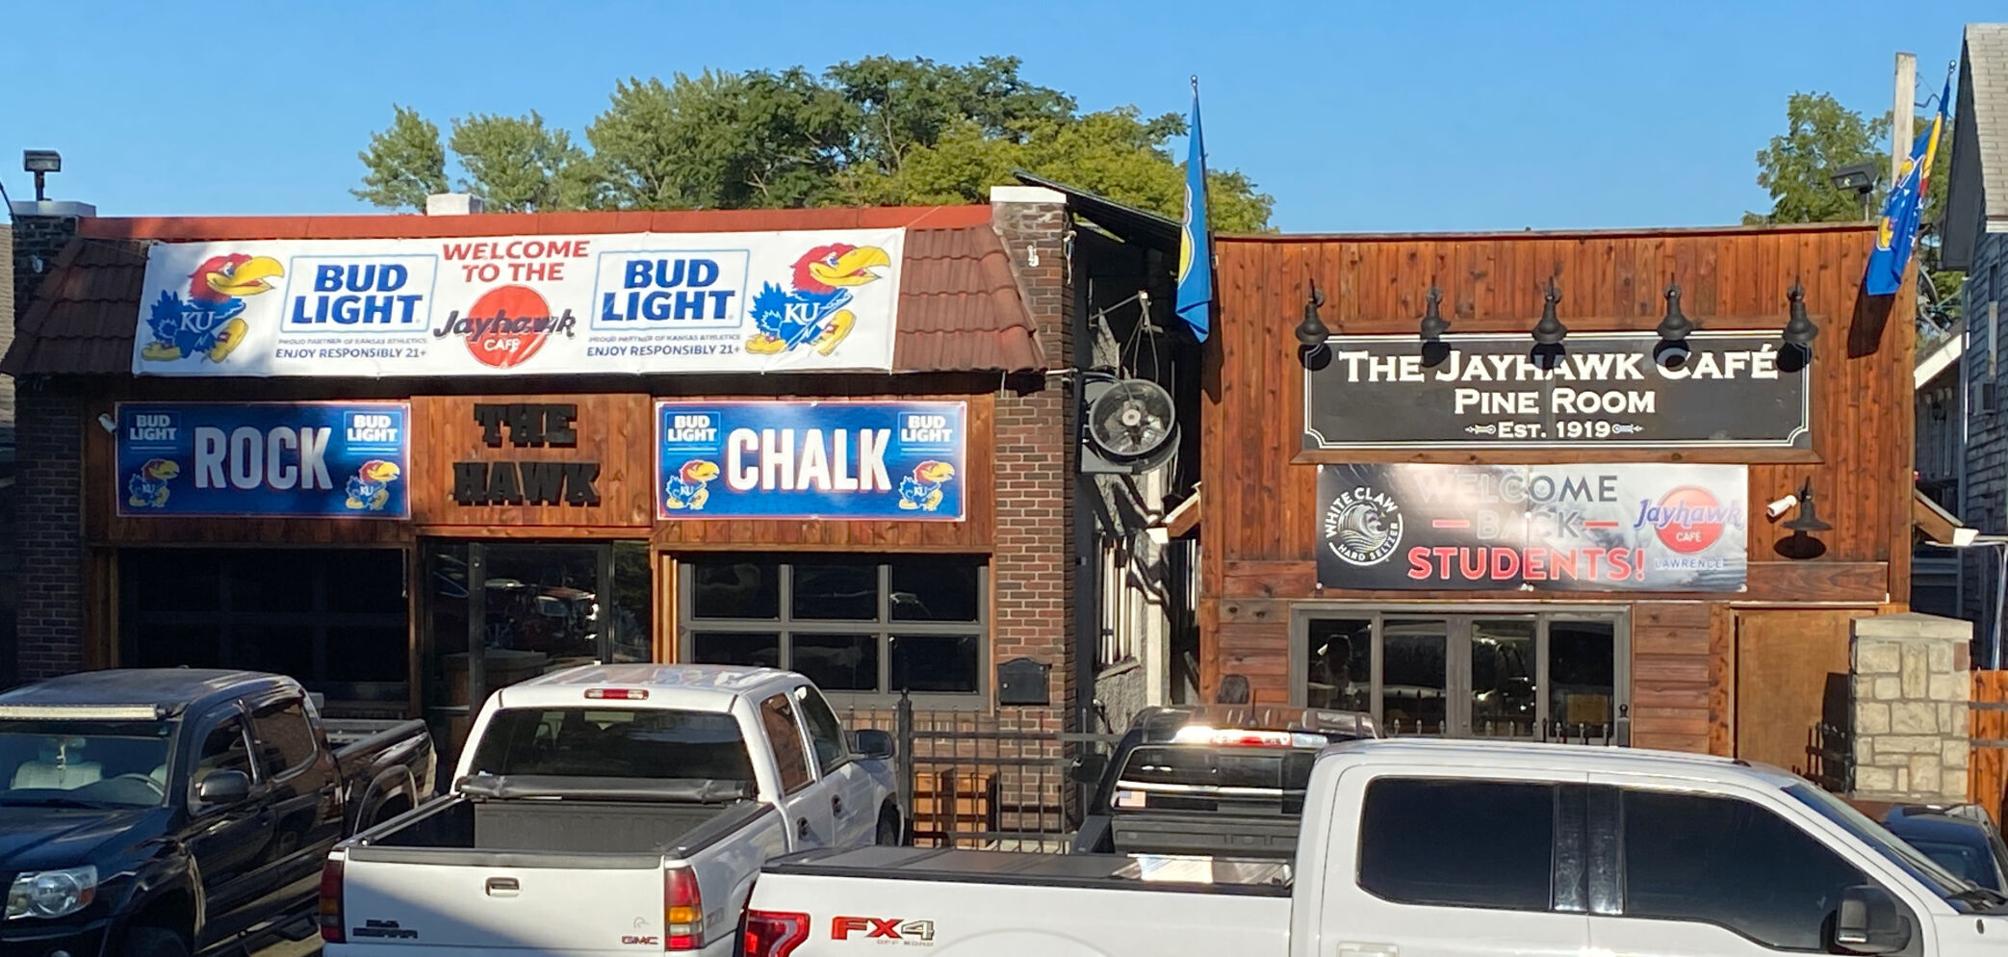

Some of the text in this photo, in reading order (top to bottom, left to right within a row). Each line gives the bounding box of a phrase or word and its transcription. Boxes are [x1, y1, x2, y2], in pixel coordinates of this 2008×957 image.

[442, 240, 591, 260] WELCOME
[314, 263, 408, 292] BUD
[462, 262, 565, 282] TO THE
[624, 258, 719, 289] BUD
[291, 294, 423, 324] LIGHT
[601, 290, 735, 321] LIGHT
[784, 302, 821, 325] KU
[180, 311, 216, 333] KU
[433, 308, 576, 342] Jayhawk
[275, 348, 427, 358] ENJOY RESPONSIBLY 21+
[587, 344, 740, 357] ENJOY RESPONSIBLY 21+
[1338, 343, 1779, 382] THE JAYHAWK CAFÉ
[1454, 387, 1656, 415] PINE ROOM
[136, 414, 170, 427] BUD
[353, 414, 392, 428] BUD
[474, 403, 578, 448] THE
[675, 414, 711, 428] BUD
[908, 414, 946, 428] BUD
[1498, 421, 1612, 439] EST. 1919
[129, 427, 177, 440] LIGHT
[346, 427, 398, 442] LIGHT
[667, 427, 717, 442] LIGHT
[901, 427, 952, 442] LIGHT
[194, 427, 333, 489] ROCK
[727, 428, 892, 490] CHALK
[453, 462, 601, 507] HAWK
[1413, 473, 1617, 503] WELCOME
[1325, 487, 1398, 538] WHITE CLAW
[1633, 498, 1745, 529] Jayhawk
[1338, 522, 1398, 561] HARD SELTZER
[1407, 546, 1646, 580] STUDENTS!
[1655, 558, 1728, 569] LAWRENCE
[621, 935, 659, 944] GMC
[831, 916, 935, 941] FX4
